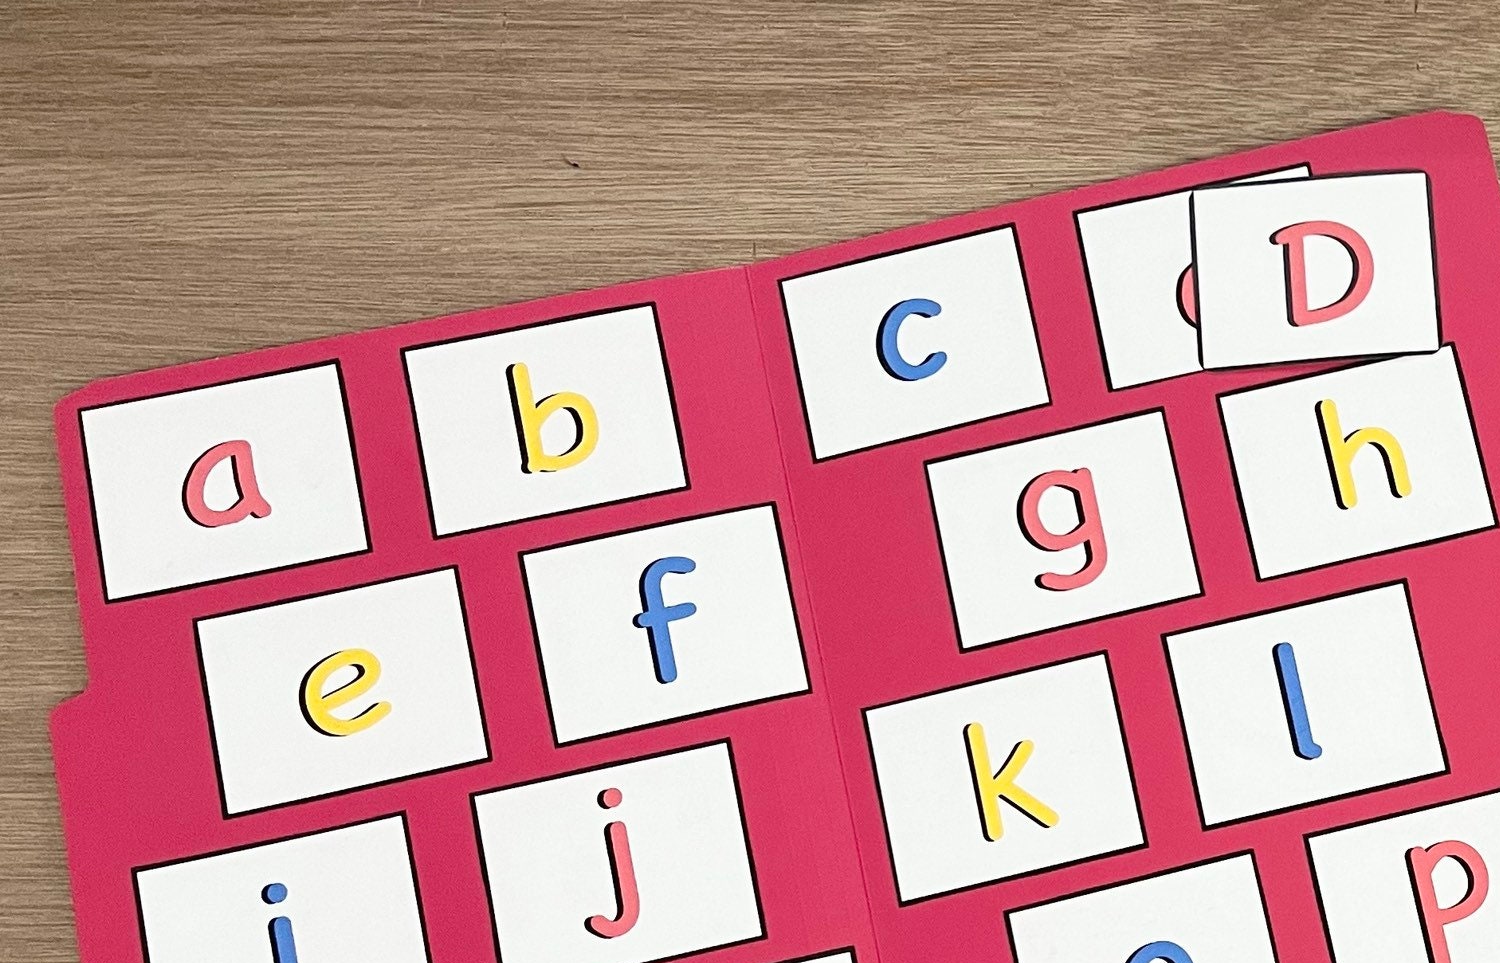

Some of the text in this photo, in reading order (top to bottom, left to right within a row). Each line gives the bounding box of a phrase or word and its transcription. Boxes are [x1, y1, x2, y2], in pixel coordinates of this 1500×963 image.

[1269, 220, 1374, 327] D
[876, 298, 947, 381] c
[506, 362, 599, 474] b
[1315, 399, 1412, 510] h
[182, 440, 272, 528] a
[1017, 467, 1107, 591] g
[632, 556, 696, 684] f
[299, 648, 392, 737] e
[1272, 642, 1322, 760] l
[963, 722, 1060, 842] k
[584, 788, 640, 939] j
